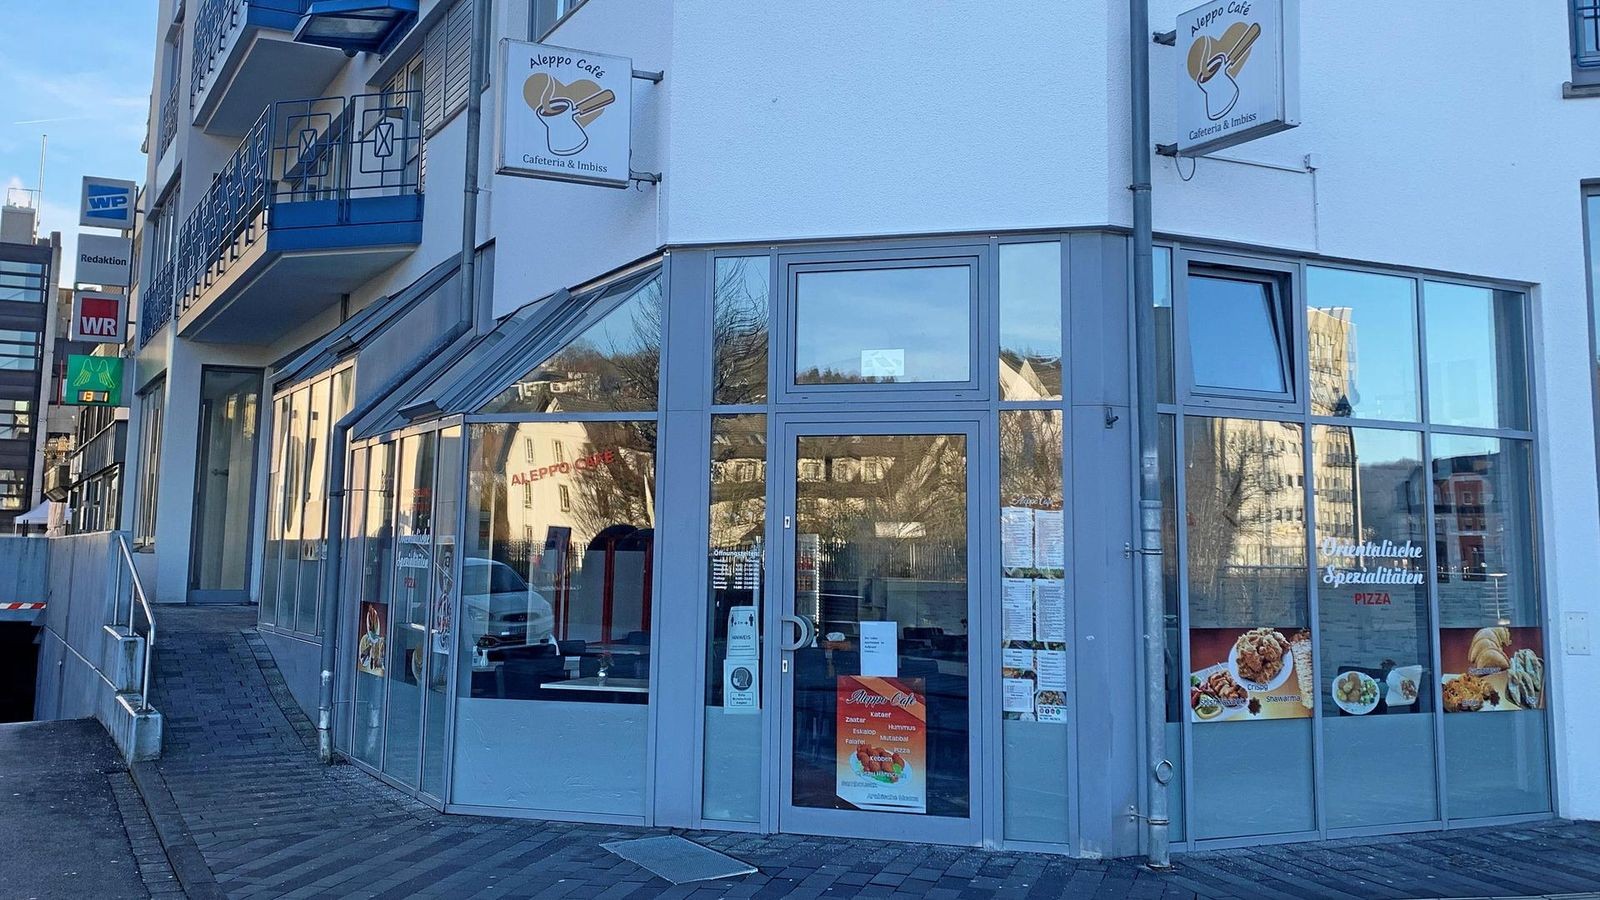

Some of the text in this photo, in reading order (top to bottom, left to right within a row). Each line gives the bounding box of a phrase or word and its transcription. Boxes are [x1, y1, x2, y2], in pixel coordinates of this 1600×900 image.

[1190, 1, 1252, 37] Aleppo Café
[530, 54, 605, 79] Aleppo Café
[1188, 112, 1257, 140] Cafeteria & Imbiss
[522, 153, 608, 173] Cafeteria & Imbiss
[88, 195, 128, 210] WP
[80, 253, 127, 266] Redaktion
[80, 316, 117, 335] WR
[511, 462, 570, 486] ALEPPO
[1322, 536, 1423, 558] Orientalische
[1323, 564, 1425, 588] Spezialitäten
[1354, 593, 1391, 605] PIZZA
[1247, 683, 1269, 691] Crispy
[846, 689, 888, 708] Aleppo
[1266, 695, 1300, 703] Shawarma
